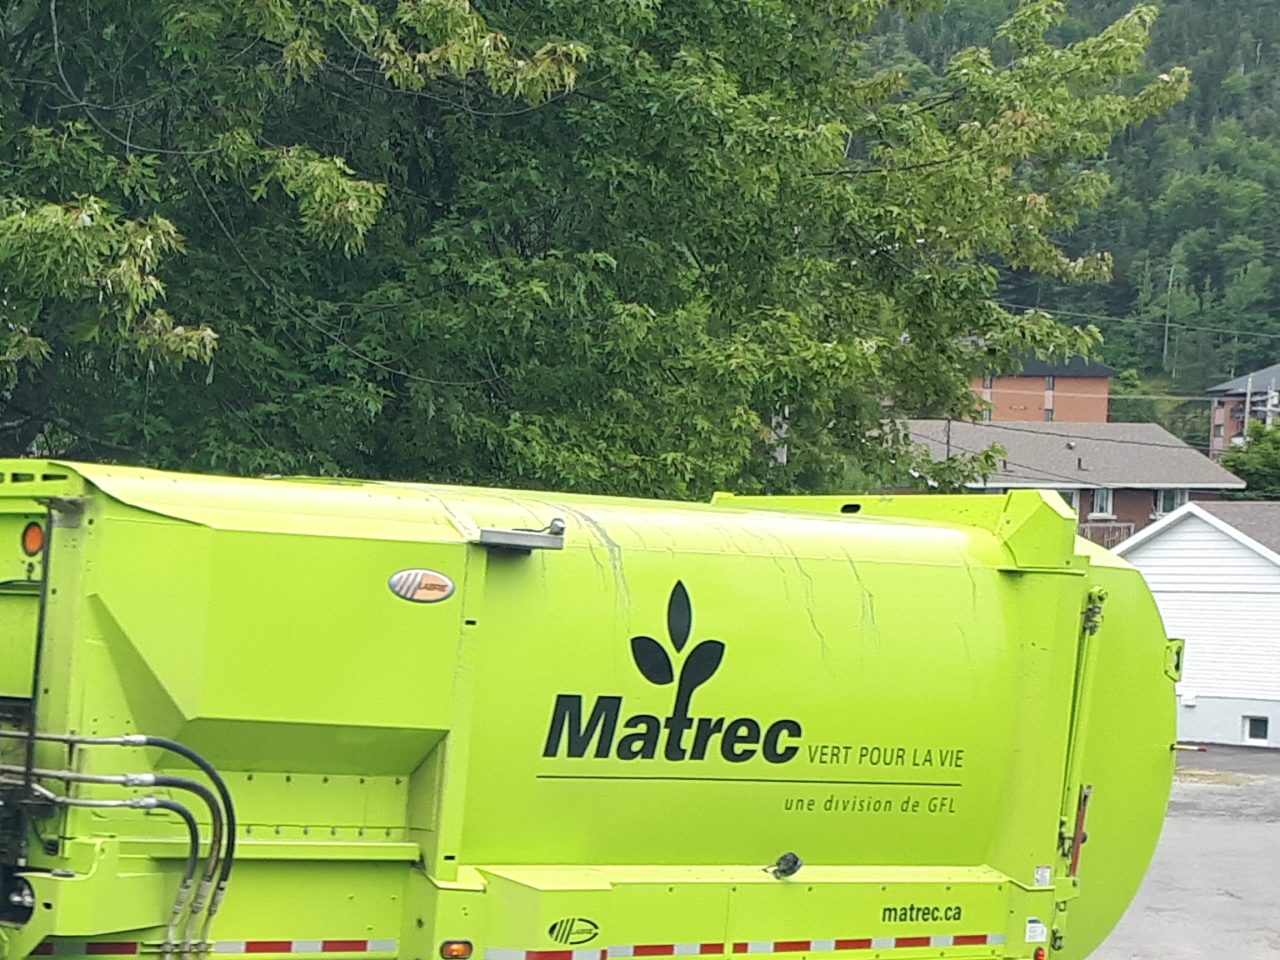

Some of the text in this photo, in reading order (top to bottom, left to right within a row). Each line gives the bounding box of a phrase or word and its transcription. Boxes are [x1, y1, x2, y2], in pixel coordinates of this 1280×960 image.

[542, 694, 965, 768] Matrec VERT POUR LA VIE
[784, 794, 956, 813] une division de GFL
[881, 903, 962, 922] matrec.ca
